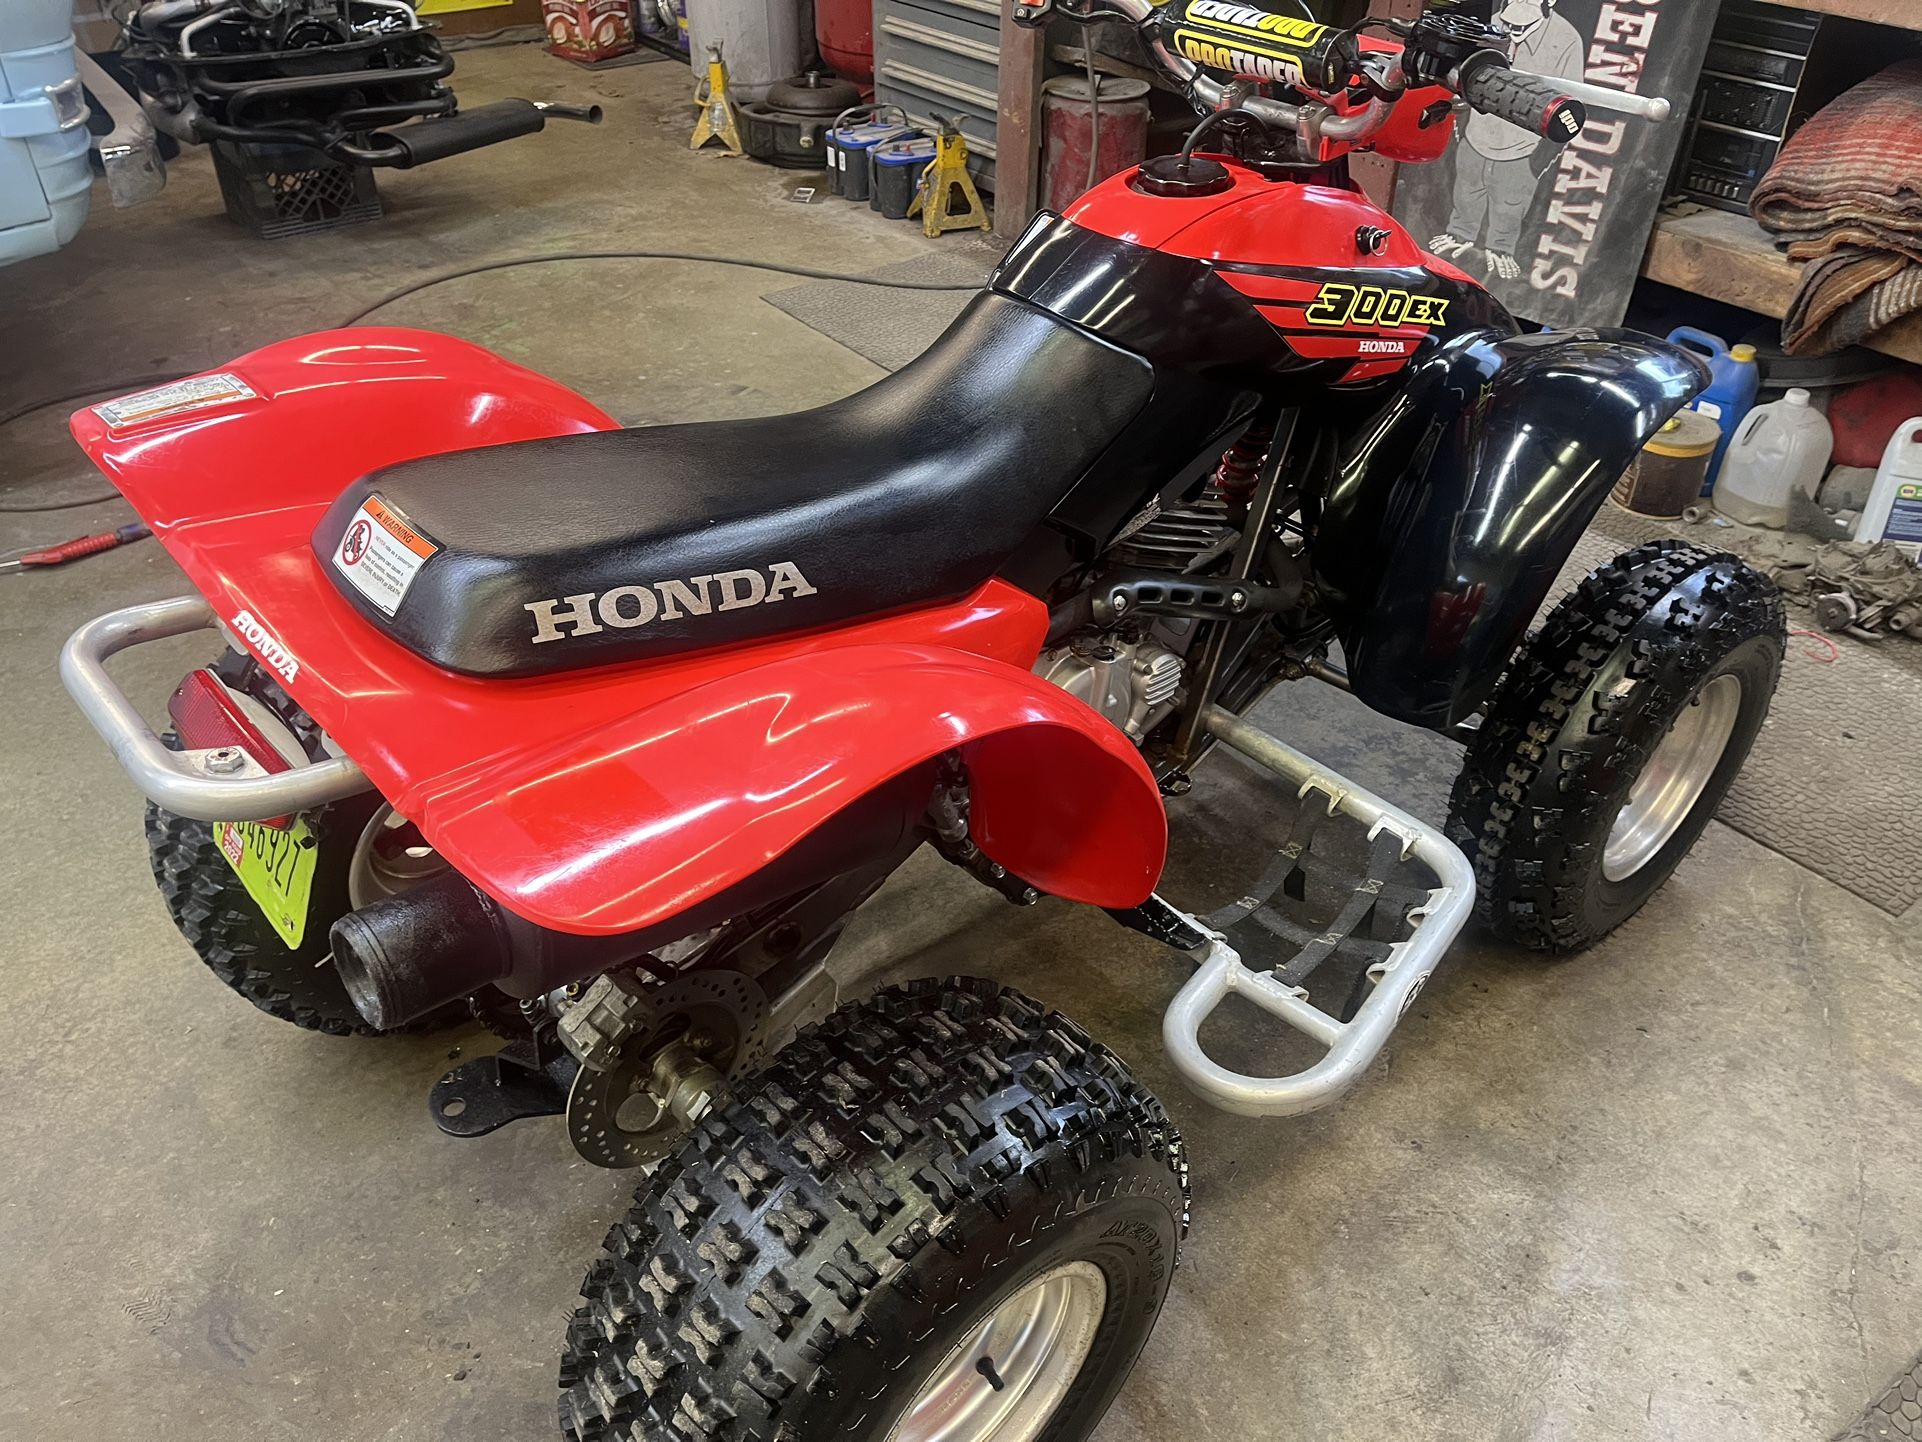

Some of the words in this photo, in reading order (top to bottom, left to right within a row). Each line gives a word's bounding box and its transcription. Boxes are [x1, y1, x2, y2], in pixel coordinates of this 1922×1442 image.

[1584, 0, 1660, 93] EN
[1530, 119, 1627, 298] DAVIS
[1305, 282, 1450, 327] 300EX
[1358, 341, 1404, 353] HONDA
[382, 515, 414, 544] WARNING
[523, 561, 818, 644] HONDA
[231, 609, 300, 685] HONDA
